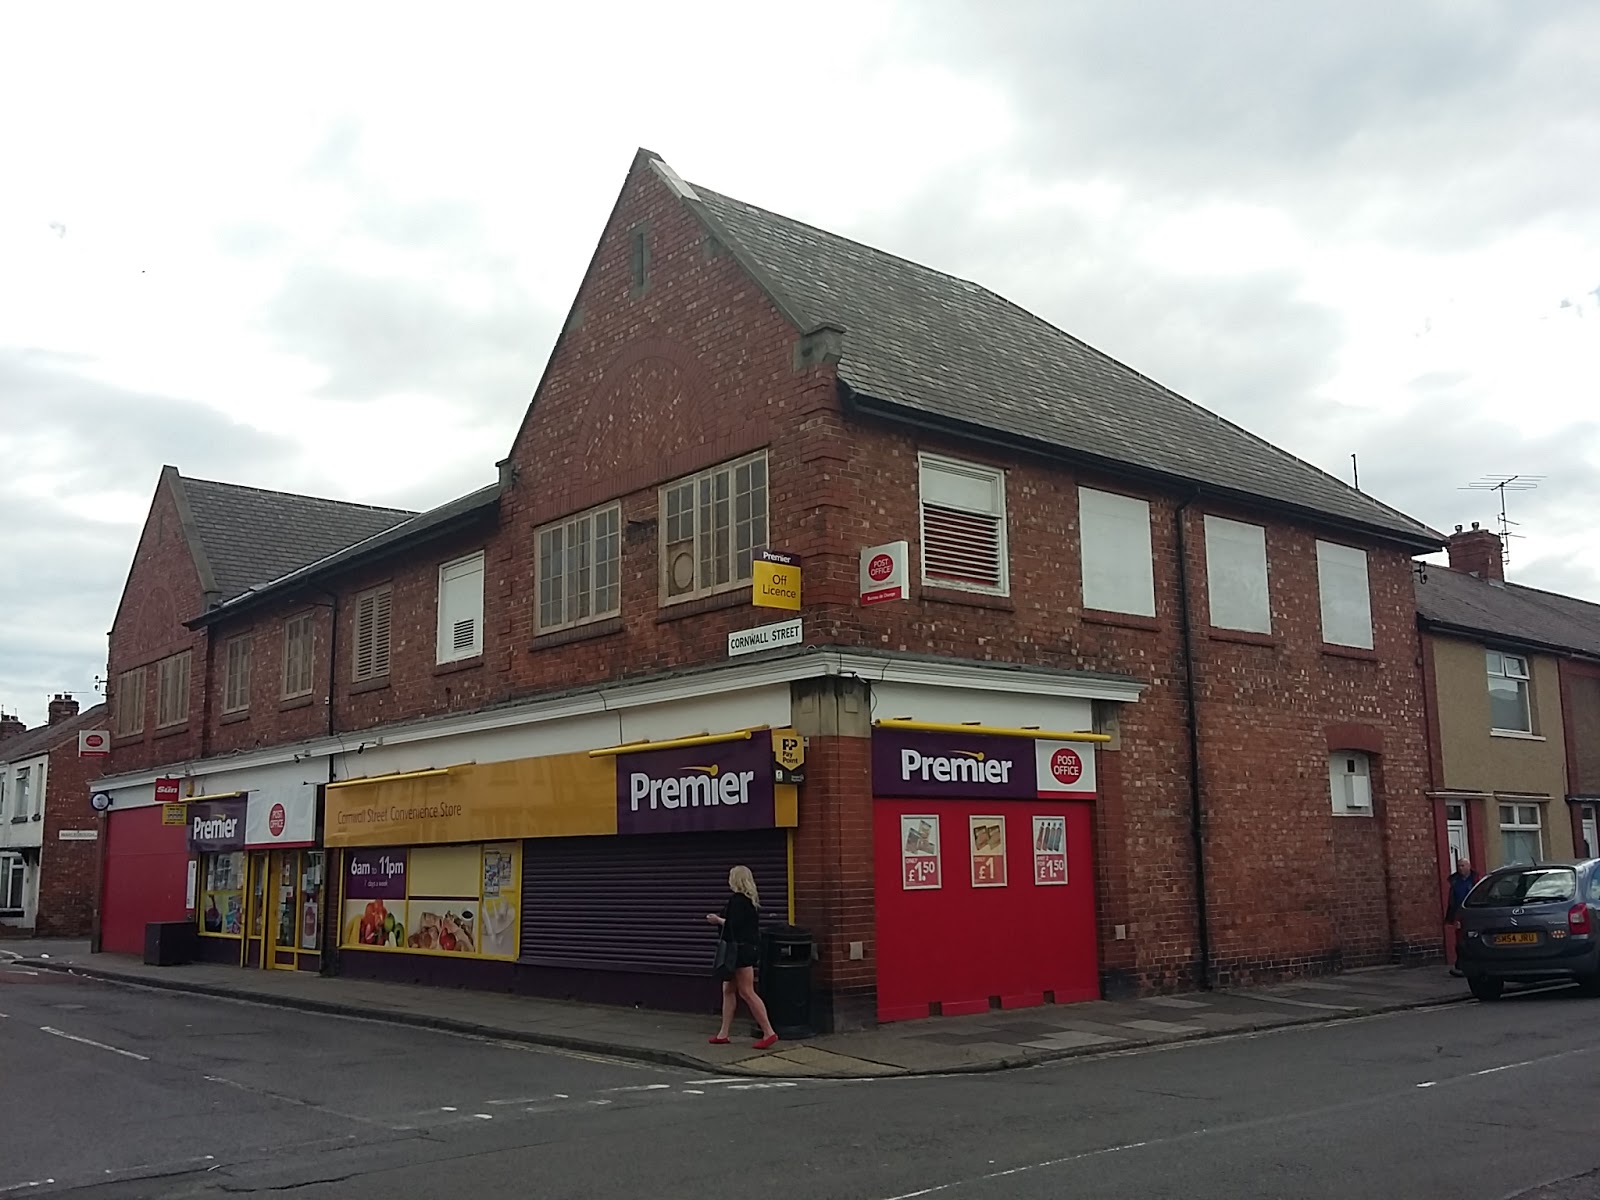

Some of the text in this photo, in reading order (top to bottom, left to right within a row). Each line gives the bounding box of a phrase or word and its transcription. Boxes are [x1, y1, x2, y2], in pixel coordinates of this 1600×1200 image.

[763, 551, 791, 563] Premier
[873, 558, 888, 568] POST
[870, 566, 890, 576] OFFICE
[772, 574, 787, 585] Off
[762, 584, 796, 598] Licence
[730, 626, 800, 650] CORNWALL STREET
[1057, 755, 1076, 765] POST
[901, 749, 1012, 784] Premier
[1053, 765, 1079, 776] OFFICE
[630, 769, 755, 812] Premier
[272, 810, 283, 818] POST
[337, 801, 462, 825] Cornwall Street Convenience Store
[193, 815, 238, 840] Premier
[270, 819, 284, 828] OFFICE
[351, 857, 370, 875] 6am
[379, 856, 404, 879] 11pm
[1519, 933, 1534, 942] JRU
